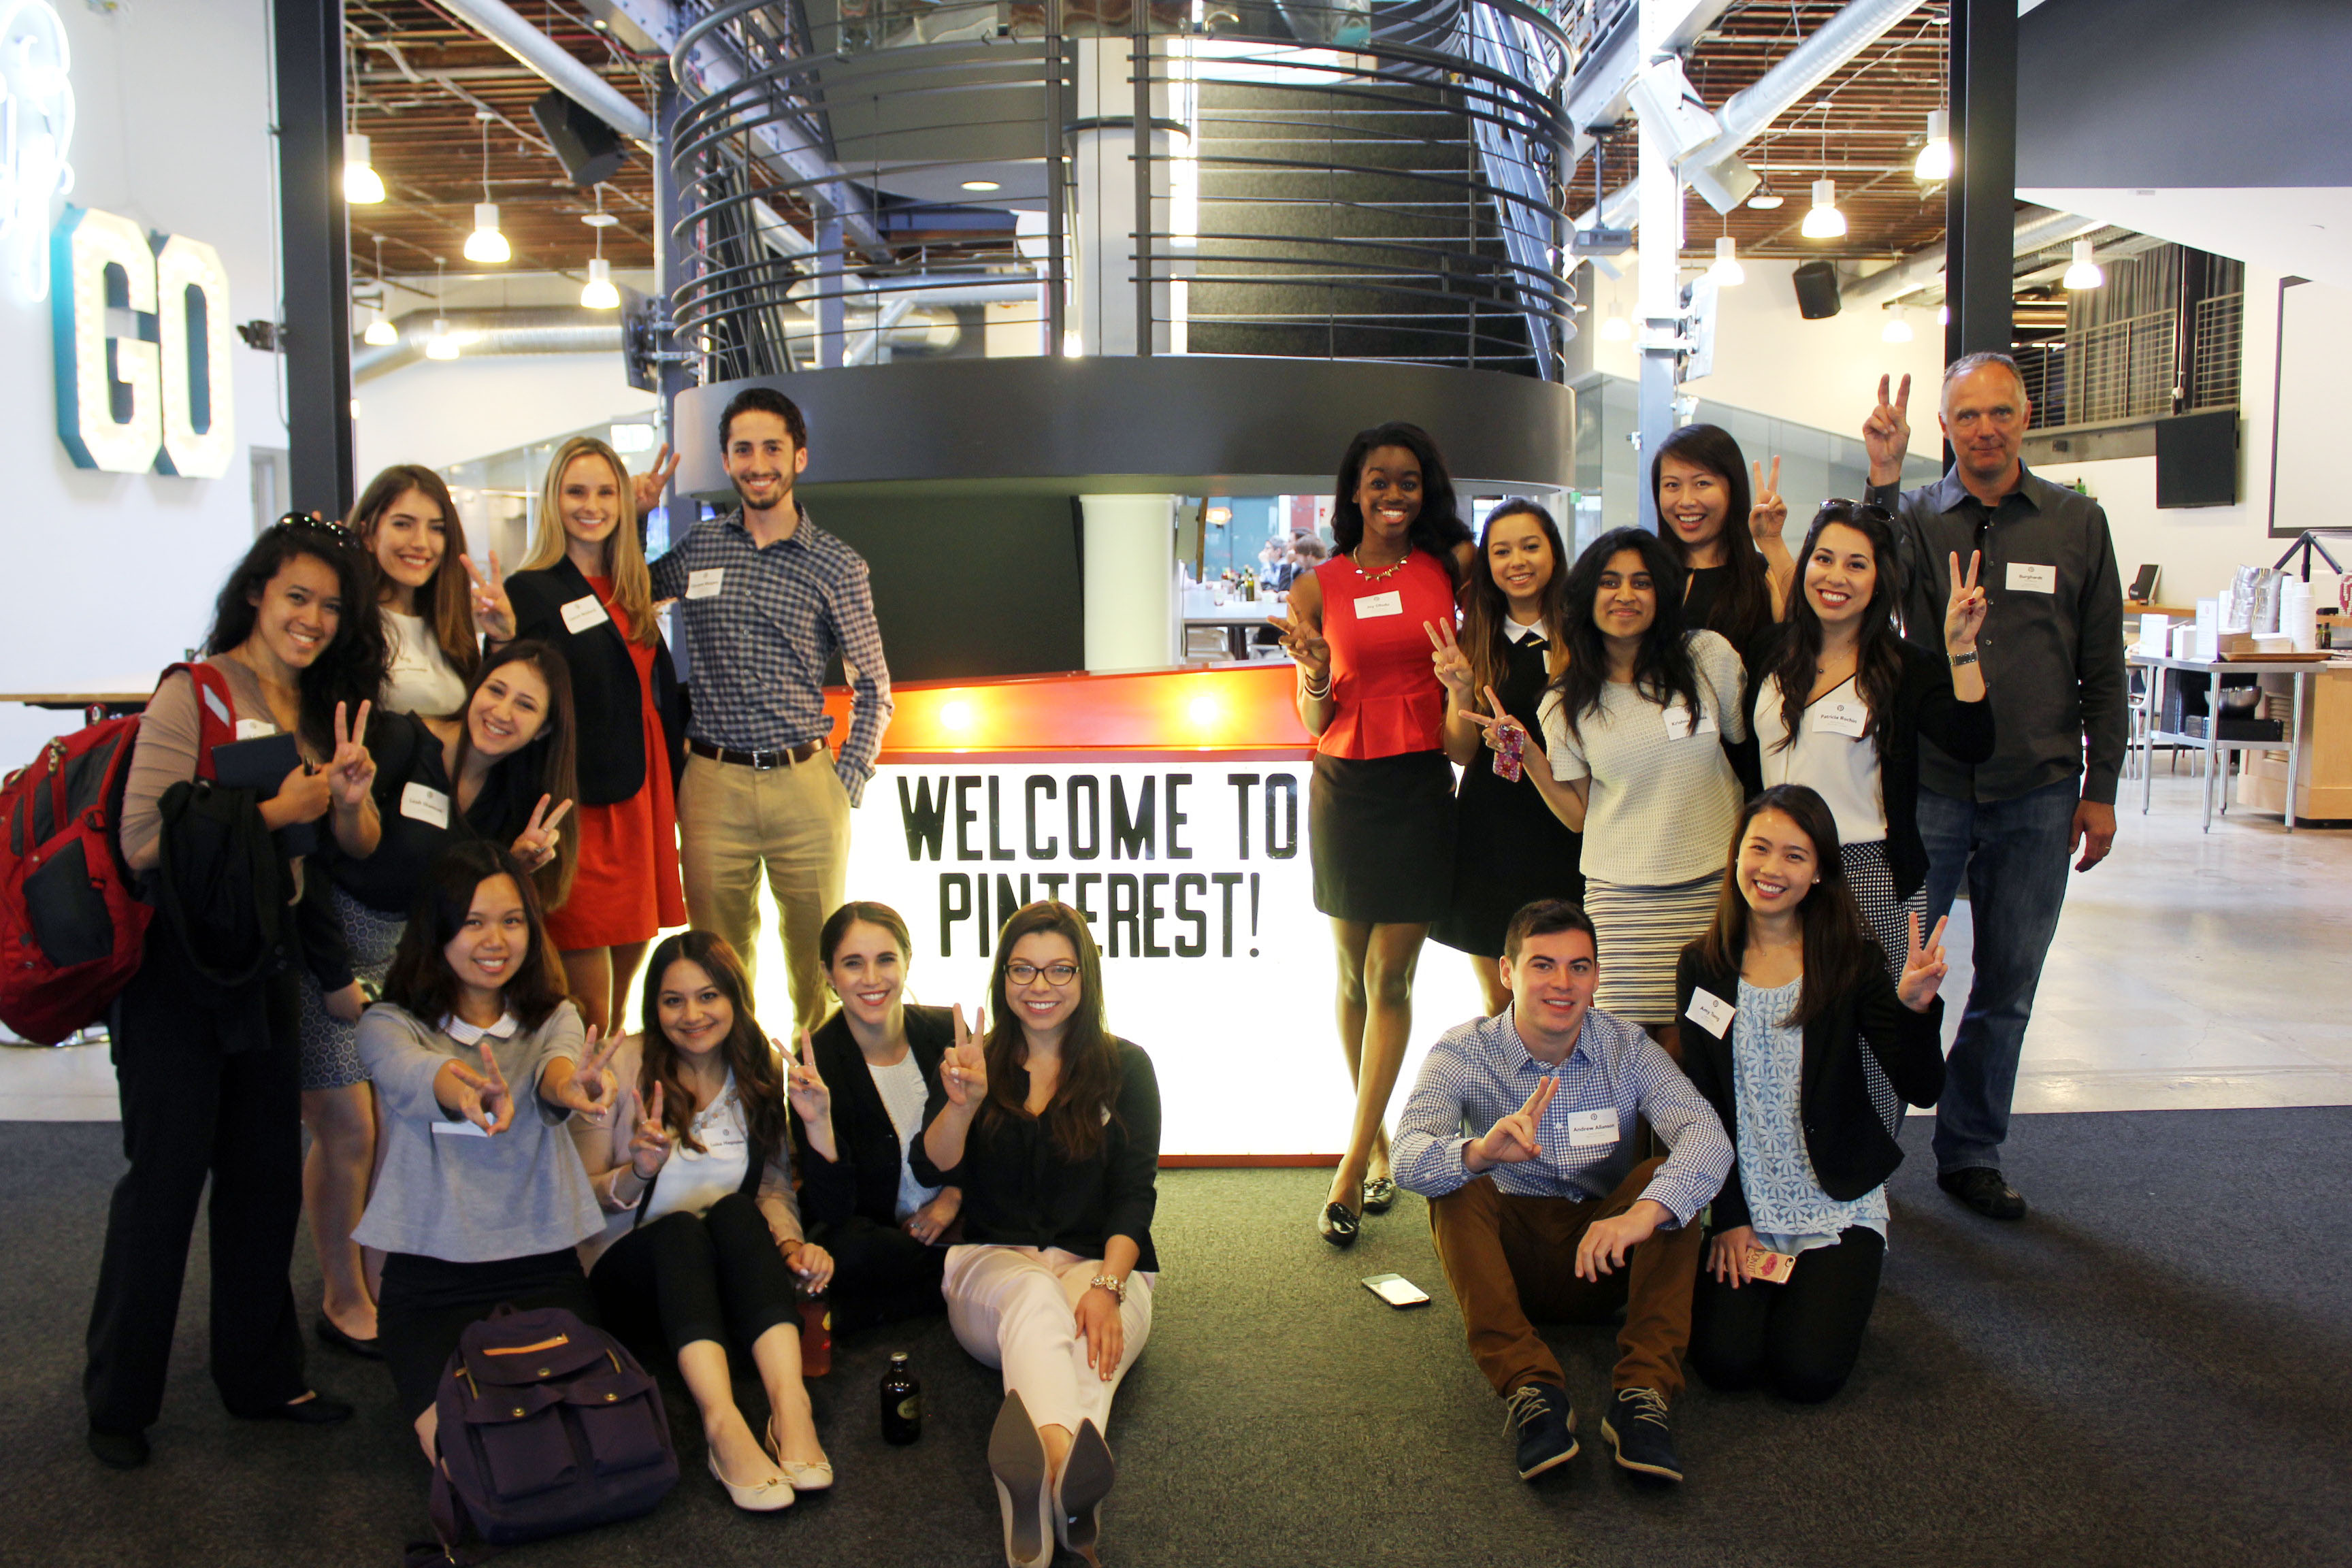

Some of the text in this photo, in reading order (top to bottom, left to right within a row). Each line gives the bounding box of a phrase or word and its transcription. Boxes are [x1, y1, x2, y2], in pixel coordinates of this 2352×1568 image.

[52, 205, 236, 480] GO
[896, 772, 1298, 861] WELCOME TO
[1699, 1005, 1710, 1015] Amy
